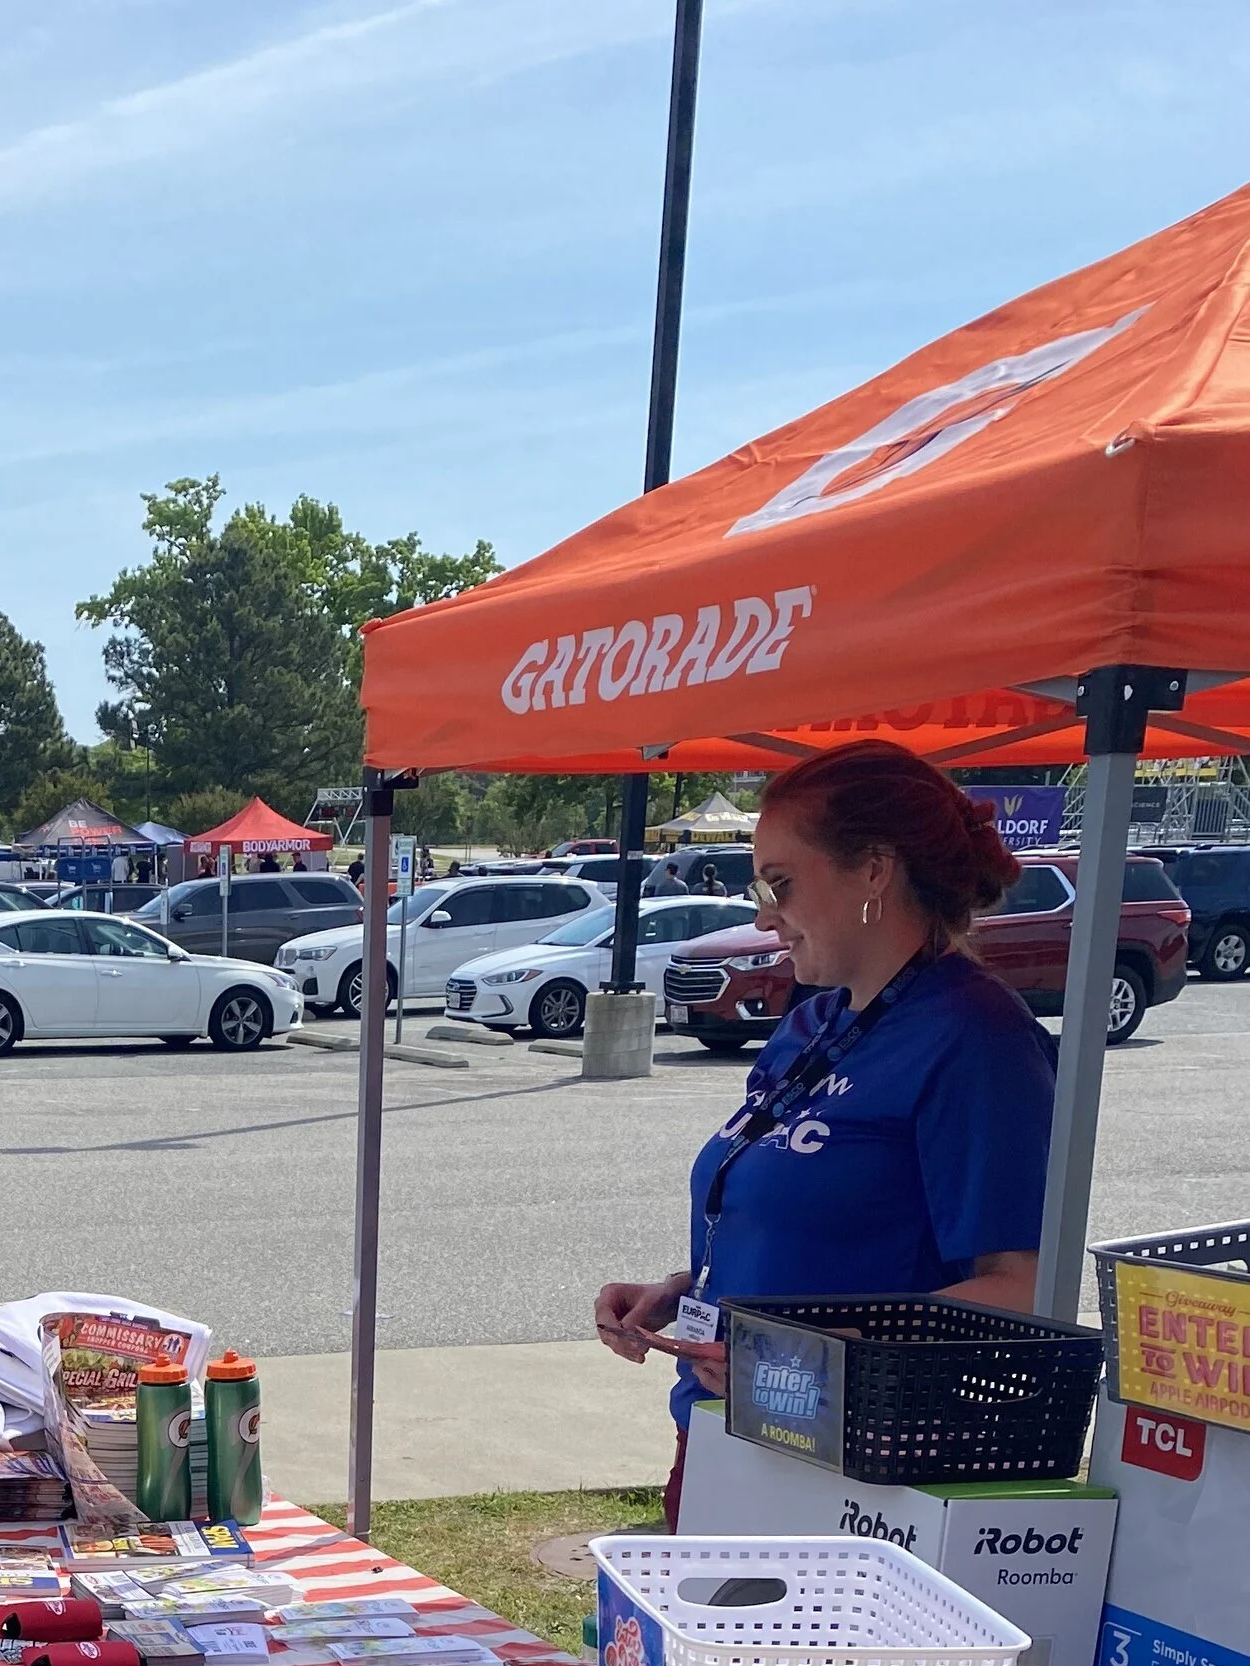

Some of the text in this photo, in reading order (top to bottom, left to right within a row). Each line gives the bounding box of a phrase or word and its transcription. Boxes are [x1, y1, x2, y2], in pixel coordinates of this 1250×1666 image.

[501, 585, 813, 714] GATORADE
[68, 820, 87, 828] BE
[997, 819, 1049, 835] LDORF
[243, 839, 311, 853] BODYARMOR
[1001, 836, 1042, 846] ERSITY
[1165, 1291, 1237, 1317] Giveaway
[81, 1323, 163, 1349] COMMISSARY
[87, 1336, 116, 1348] SHOPPER
[1141, 1350, 1175, 1371] TO
[105, 1368, 138, 1389] GRIL
[755, 1363, 812, 1393] Enter
[755, 1387, 818, 1416] to Win!
[1150, 1381, 1192, 1405] APPLE
[761, 1423, 816, 1452] A ROOMBA!
[1137, 1416, 1193, 1458] TCL
[839, 1499, 917, 1553] iRobot
[973, 1527, 1084, 1555] iRobot
[997, 1568, 1075, 1585] Roomba
